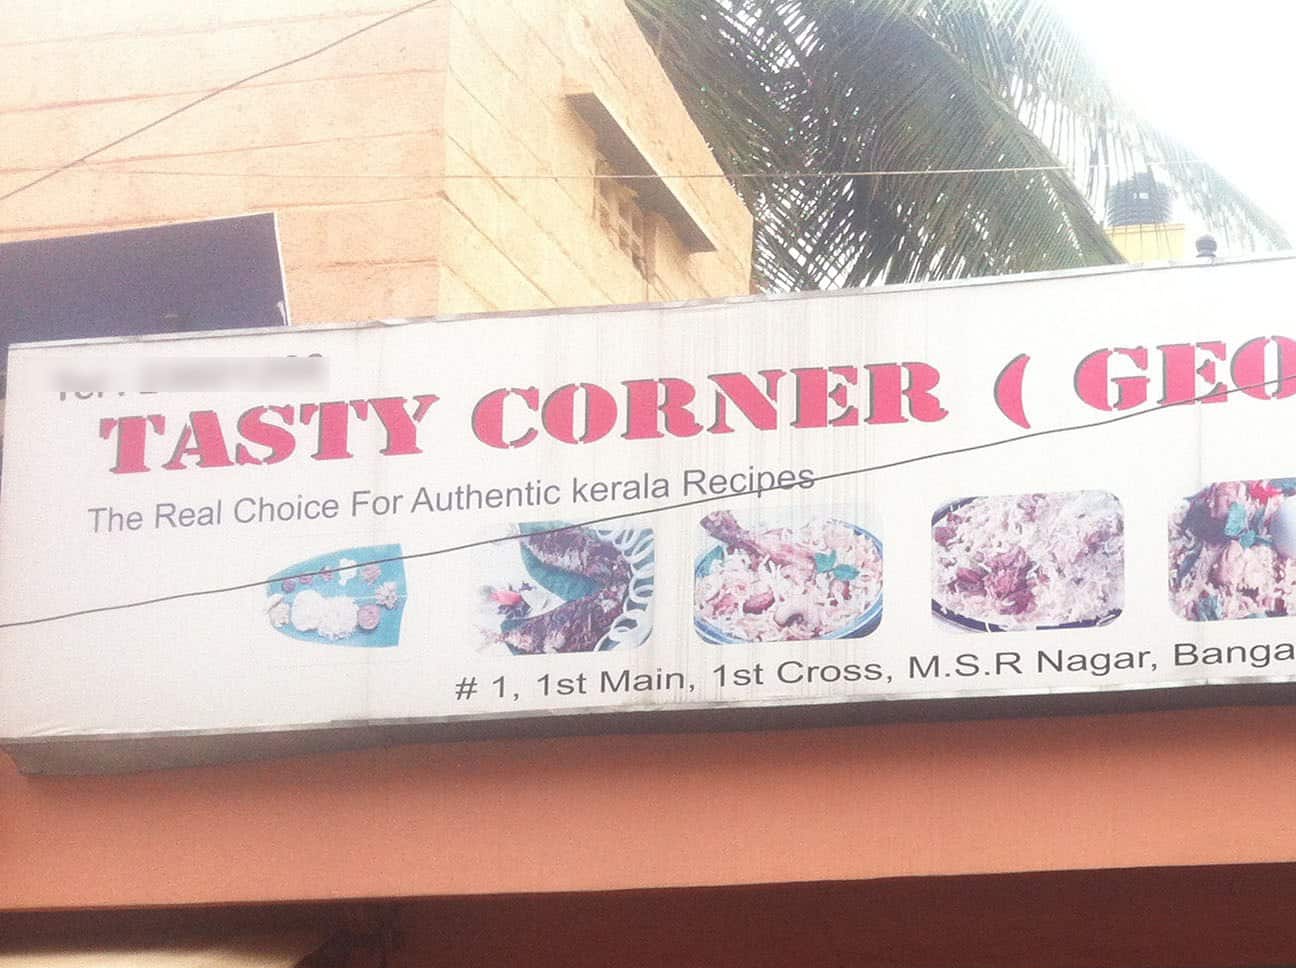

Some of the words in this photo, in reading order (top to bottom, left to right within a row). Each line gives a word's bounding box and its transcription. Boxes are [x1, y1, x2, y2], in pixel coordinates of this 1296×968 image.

[99, 395, 441, 475] TASTY
[471, 361, 949, 451] CORNER
[88, 506, 143, 533] The
[154, 500, 222, 529] Real
[233, 494, 339, 524] Choice
[351, 490, 403, 517] For
[410, 479, 561, 513] Authentic
[572, 472, 670, 503] kerala
[683, 465, 815, 499] Recipes
[536, 672, 587, 696] 1st
[600, 667, 696, 693] Main,
[712, 663, 764, 687] 1st
[777, 659, 893, 684] Cross,
[908, 651, 1024, 680] M.S.R
[1036, 645, 1158, 677] Nagar,
